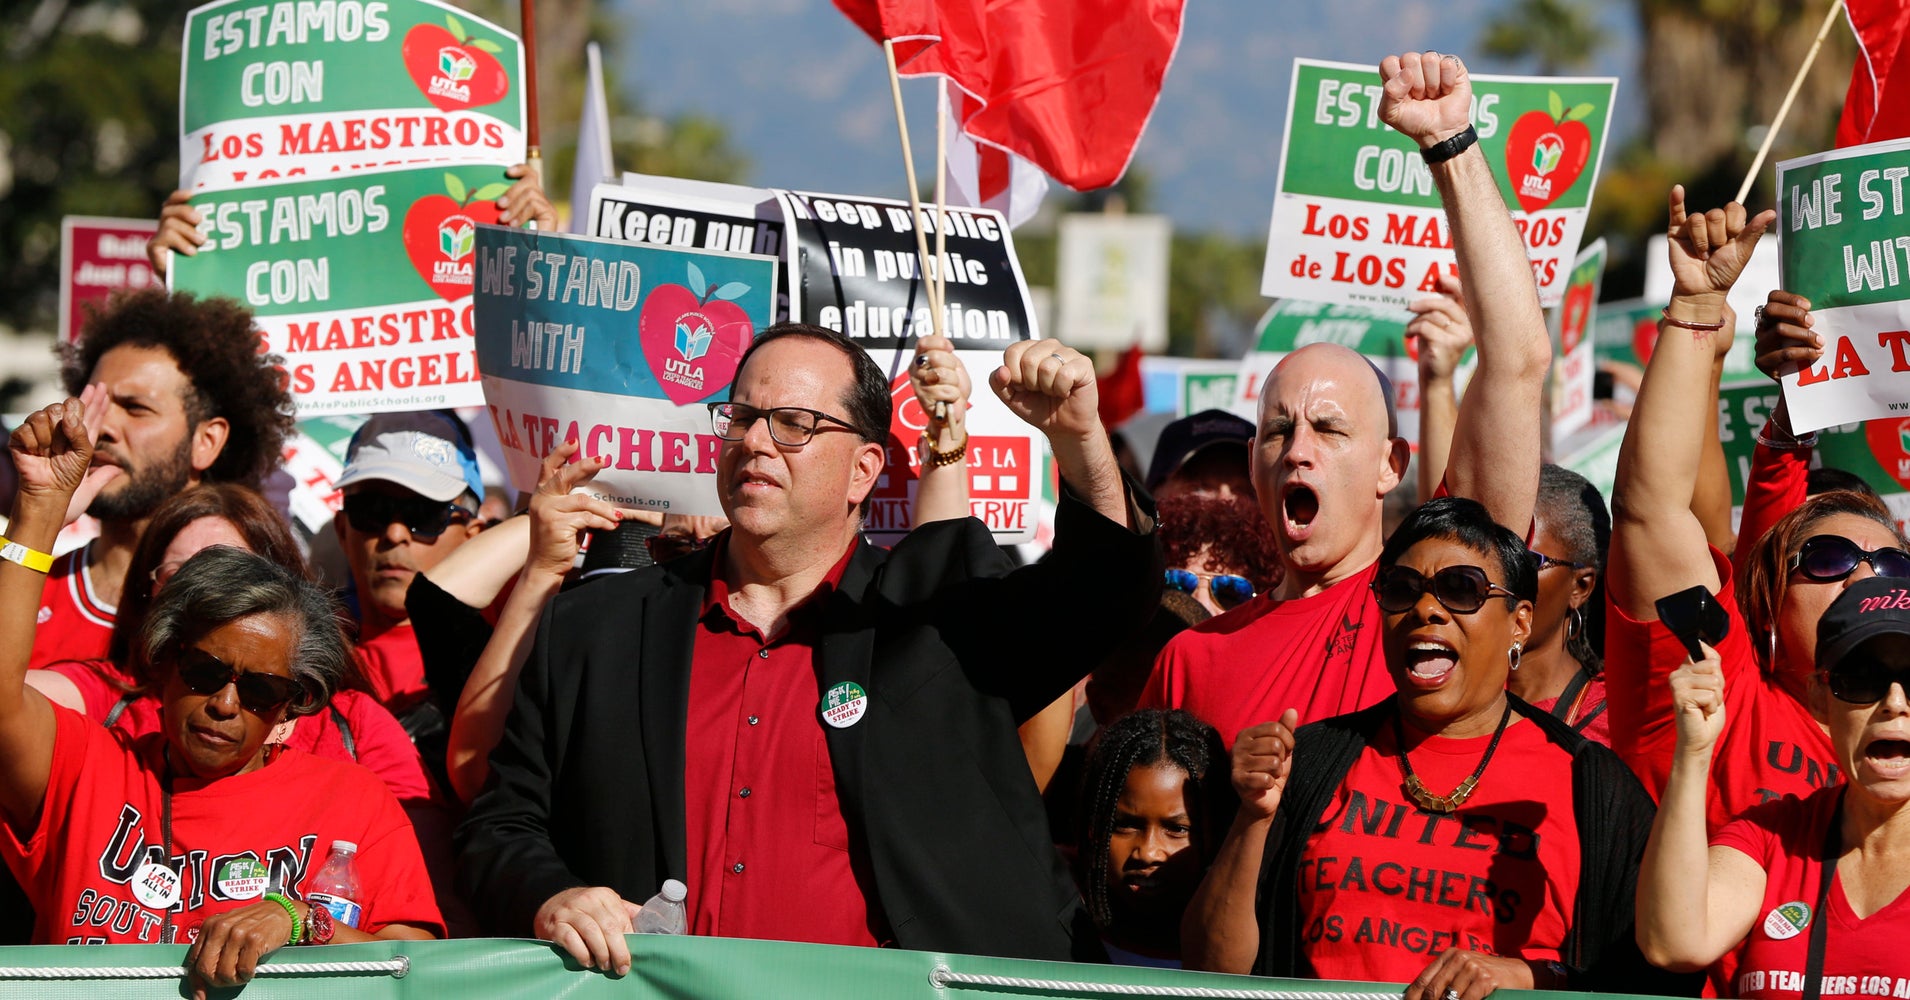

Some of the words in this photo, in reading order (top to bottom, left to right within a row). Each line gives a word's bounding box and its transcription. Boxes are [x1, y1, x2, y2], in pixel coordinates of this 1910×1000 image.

[204, 0, 390, 61] ESTAMOS
[241, 60, 323, 107] CON
[431, 75, 470, 97] UTLA
[1314, 78, 1500, 139] ESTS
[200, 132, 263, 164] Los
[279, 116, 504, 155] MAESTROS
[1354, 145, 1433, 196] CON
[1522, 174, 1552, 192] UTLA
[195, 185, 389, 252] ESTAMOS
[786, 193, 883, 230] Keep
[885, 206, 1000, 242] public
[1791, 173, 1843, 233] WE
[600, 200, 697, 247] Keep
[1302, 204, 1369, 241] Los
[246, 257, 329, 306] CON
[433, 261, 473, 276] UTLA
[481, 245, 517, 297] WE
[526, 249, 641, 312] STAND
[828, 241, 867, 278] in
[874, 249, 989, 286] public
[1290, 255, 1322, 279] de
[1331, 251, 1406, 289] LOS
[819, 300, 1011, 340] education
[511, 320, 585, 374] WITH
[1797, 335, 1870, 387] LA
[665, 358, 705, 380] UTLA
[489, 404, 525, 451] LA
[993, 447, 1017, 468] LA
[589, 492, 670, 509] Schools.org
[827, 704, 849, 717] READY
[851, 699, 861, 708] TO
[828, 686, 845, 698] ASK
[832, 708, 859, 723] STRIKE
[99, 803, 319, 913] UNION
[230, 861, 249, 870] ASK
[142, 878, 157, 892] ALL
[159, 889, 170, 899] IN
[148, 872, 173, 893] UTLA
[159, 871, 176, 885] AM
[225, 879, 250, 887] READY
[230, 885, 259, 893] STRIKE
[1300, 856, 1521, 924] TEACHERS
[1301, 915, 1344, 945] OS
[1860, 975, 1891, 996] LOS
